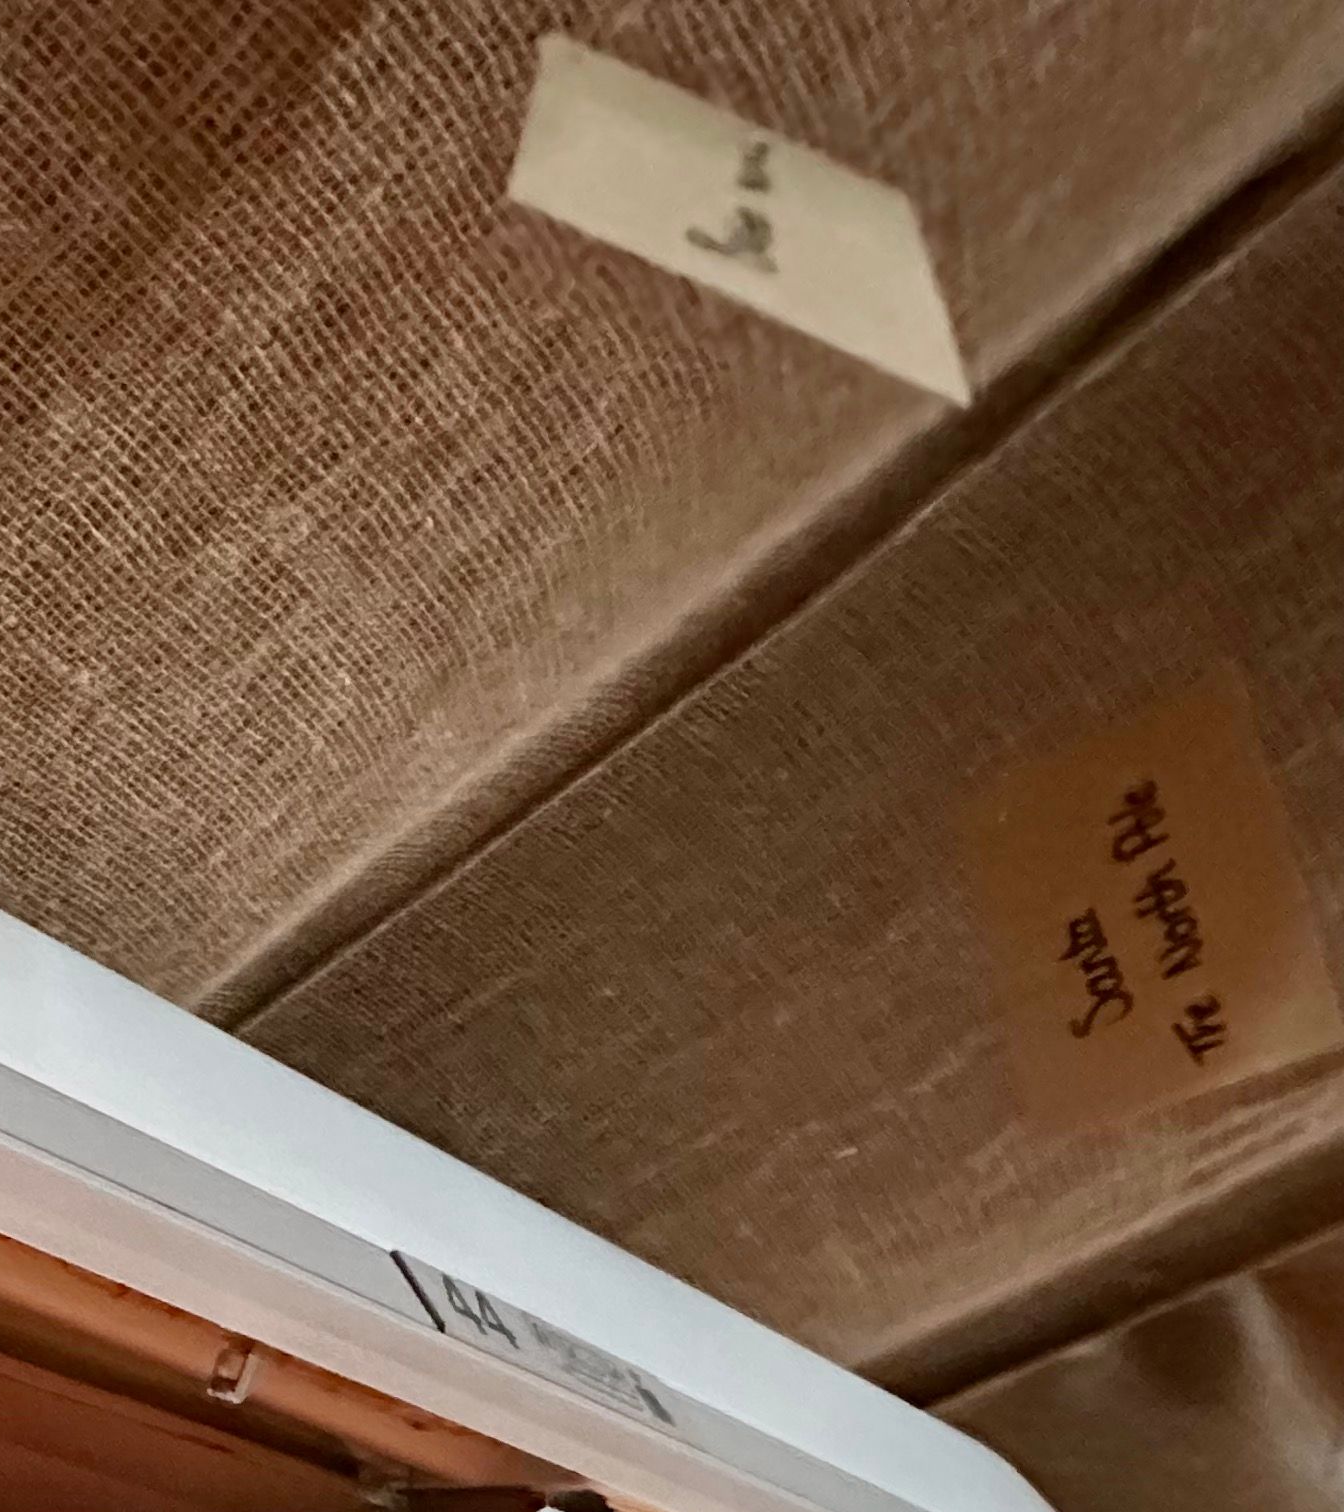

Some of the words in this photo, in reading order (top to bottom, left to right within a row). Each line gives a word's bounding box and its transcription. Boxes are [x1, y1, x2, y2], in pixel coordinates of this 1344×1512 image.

[1107, 780, 1169, 863] Pole
[1133, 857, 1204, 980] North
[1059, 906, 1134, 1038] Santa
[1171, 994, 1227, 1068] The
[442, 1273, 520, 1349] 44
